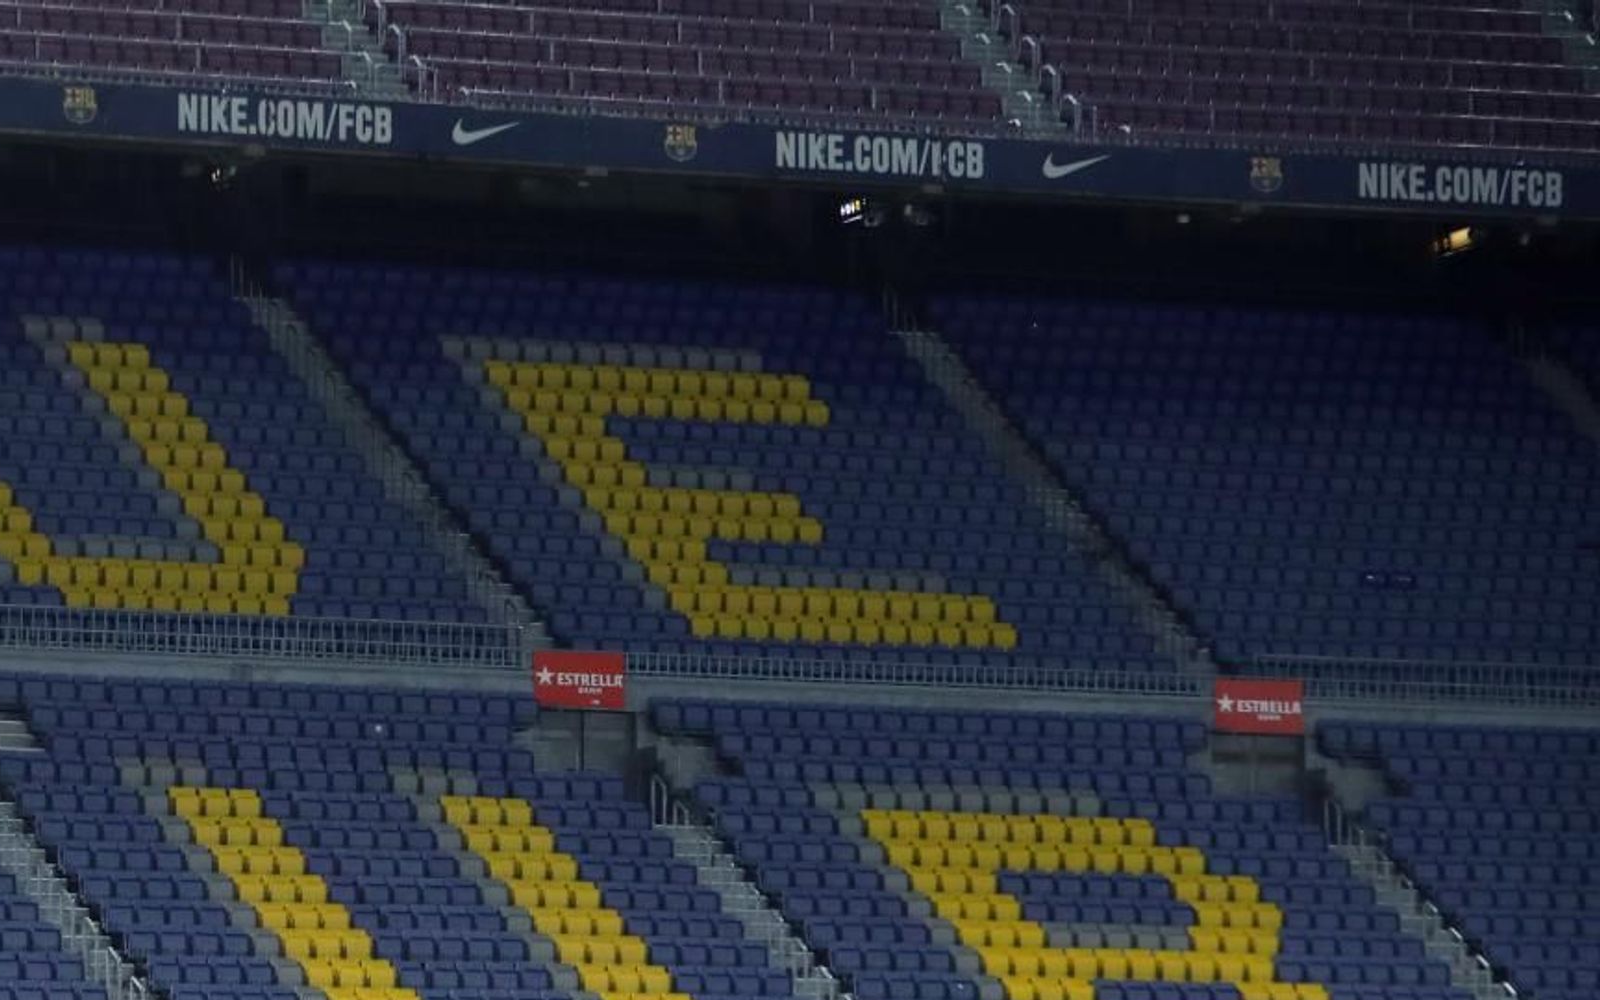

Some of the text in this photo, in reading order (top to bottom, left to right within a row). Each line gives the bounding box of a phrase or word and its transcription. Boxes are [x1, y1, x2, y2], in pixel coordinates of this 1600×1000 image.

[178, 93, 393, 144] NIKE.COM/FCB
[1358, 162, 1563, 208] NIKE.COM/FCB
[557, 672, 623, 687] ESTRELLA
[1237, 699, 1302, 714] ESTRELLA
